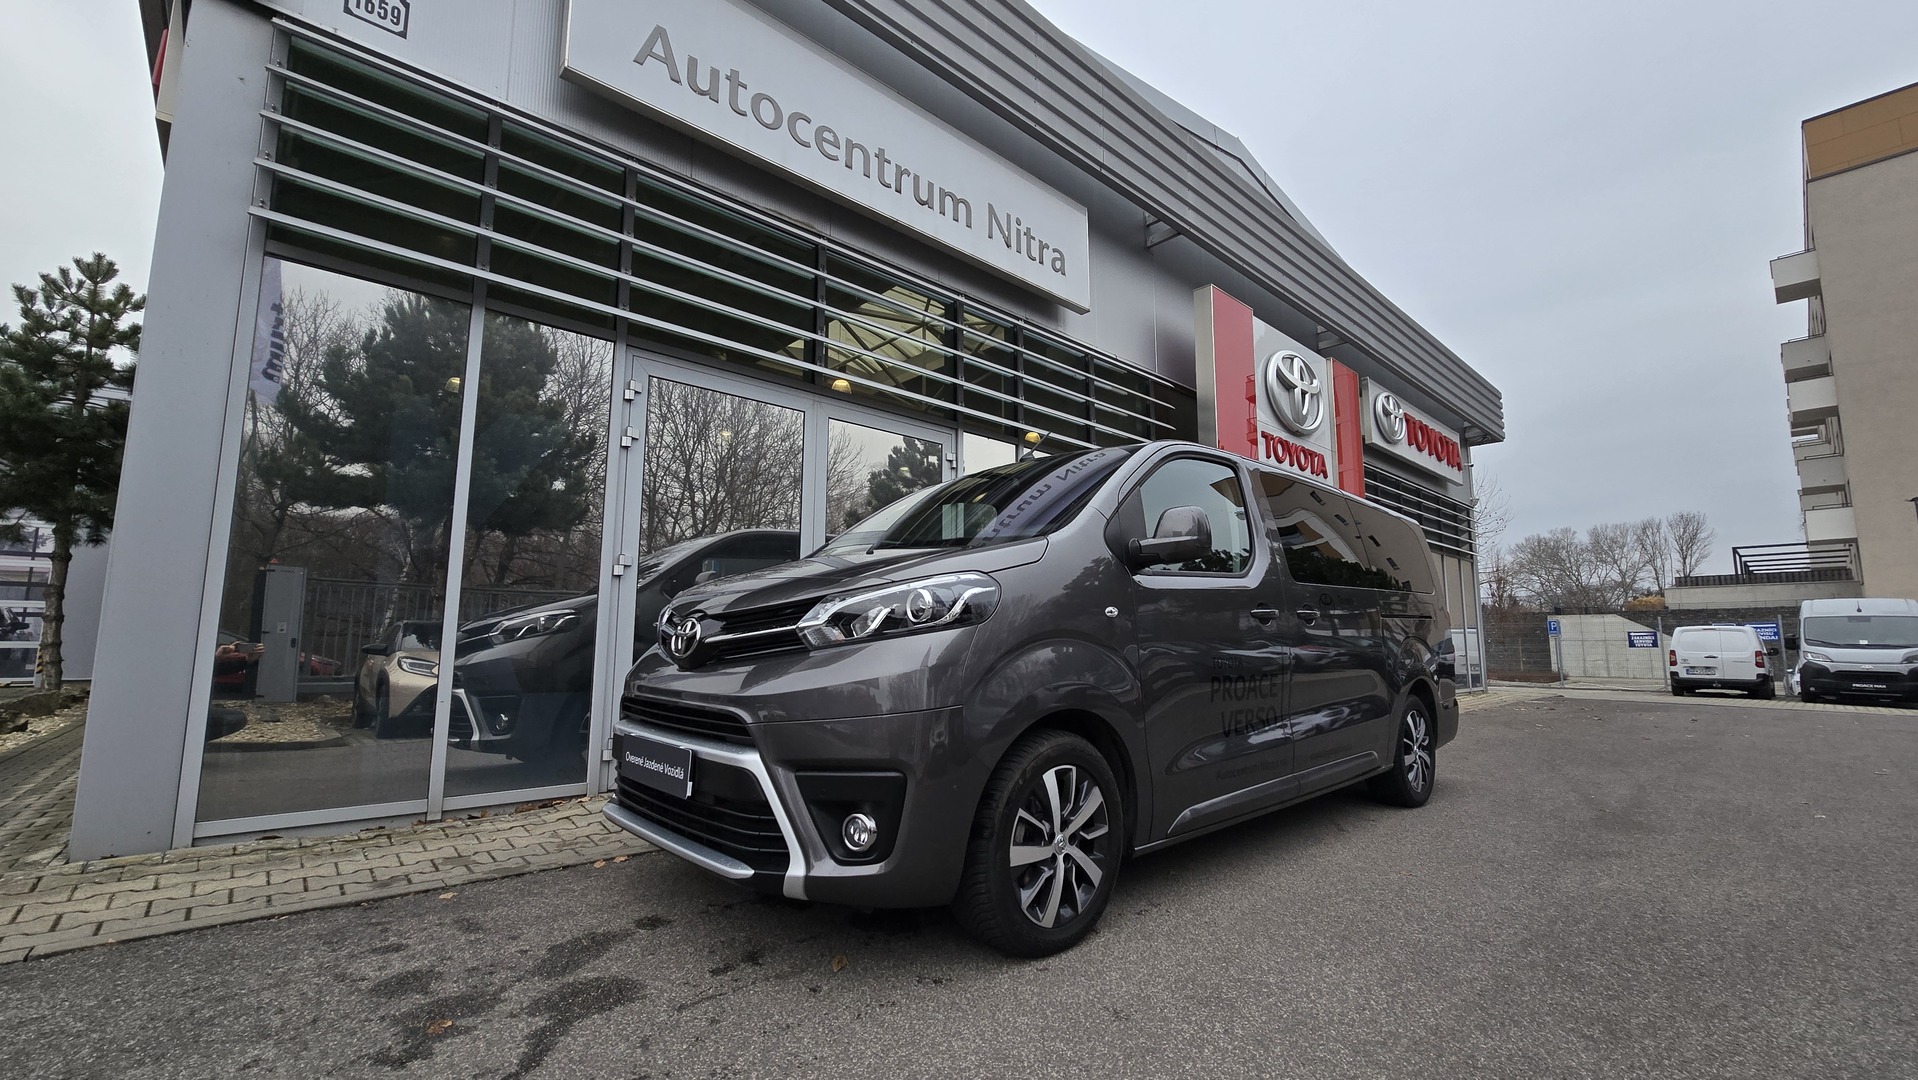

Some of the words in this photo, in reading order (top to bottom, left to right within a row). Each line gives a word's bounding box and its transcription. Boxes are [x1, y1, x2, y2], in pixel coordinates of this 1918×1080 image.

[632, 23, 973, 230] Autocentrum
[987, 202, 1067, 277] Nitra
[1260, 430, 1329, 480] TOYOTA
[1403, 412, 1463, 472] TOYOTA
[1210, 673, 1279, 703] PROACE
[1221, 706, 1278, 738] VERSO
